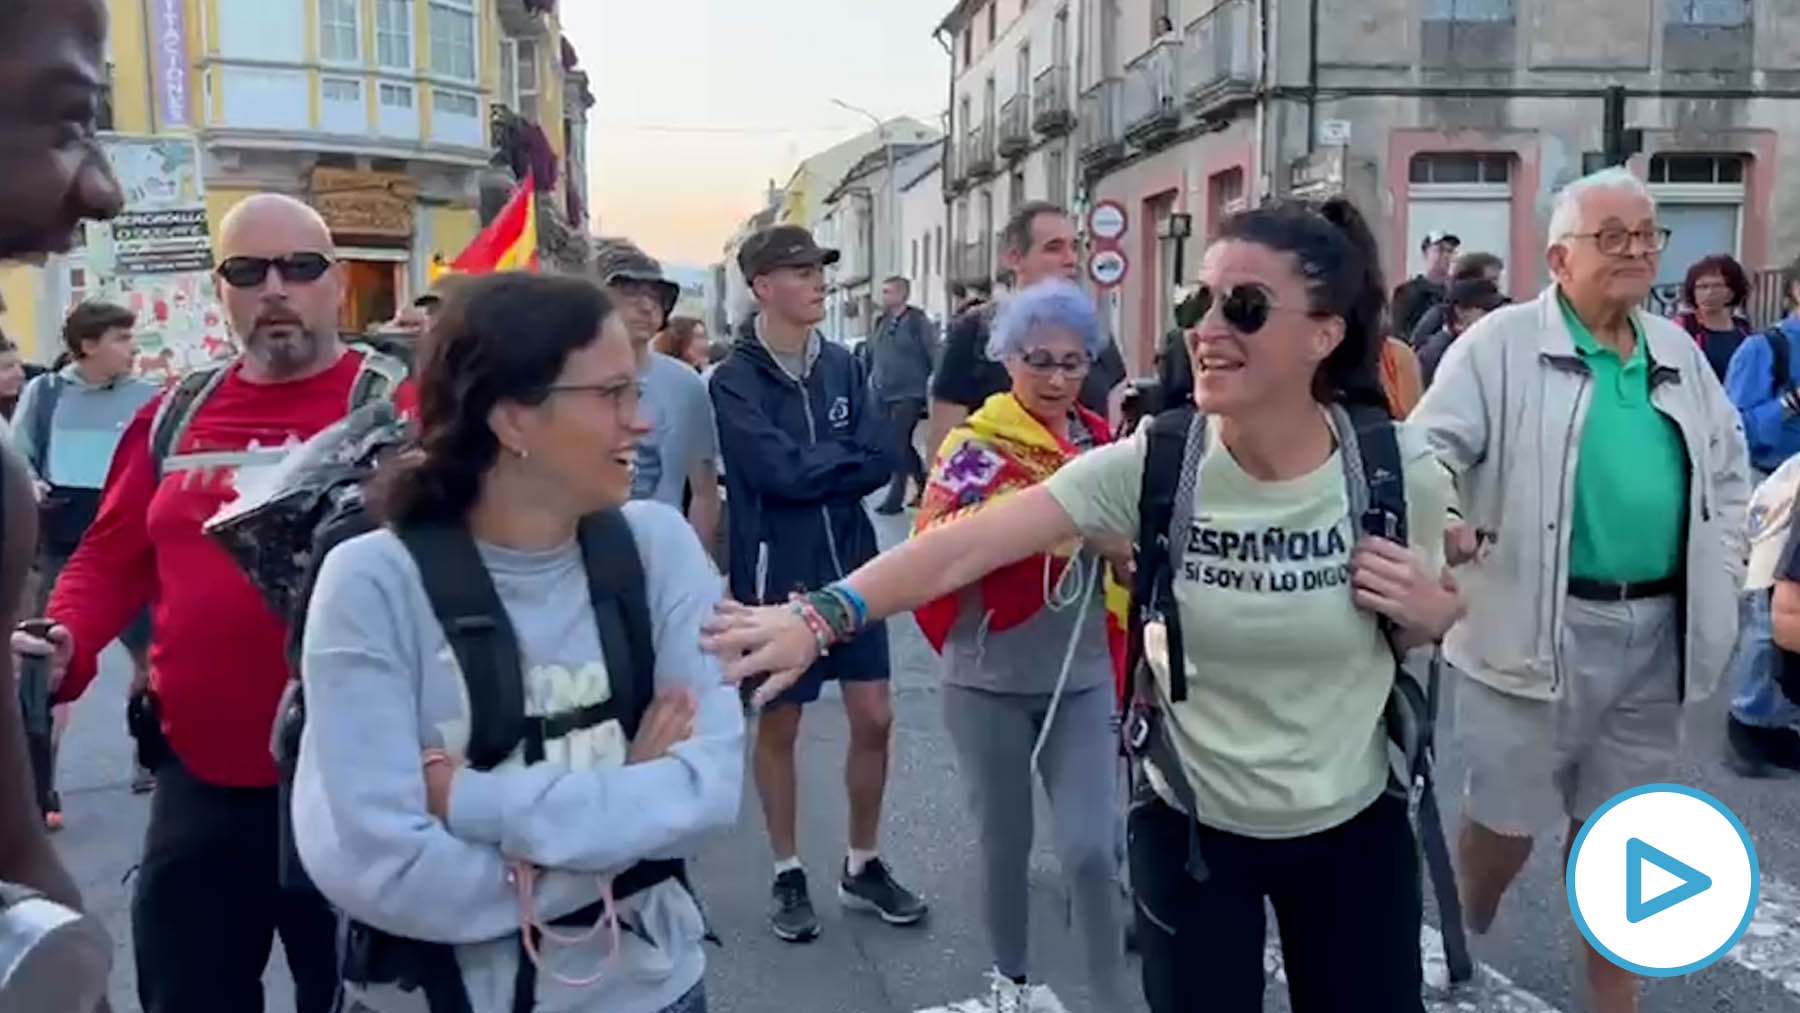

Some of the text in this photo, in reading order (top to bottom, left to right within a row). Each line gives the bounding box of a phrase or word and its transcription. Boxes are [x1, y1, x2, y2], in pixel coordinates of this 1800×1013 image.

[1187, 525, 1346, 563] ESPAÑOLA
[1203, 564, 1244, 590] SOY
[1250, 572, 1264, 592] Y
[1270, 571, 1298, 592] LO
[1303, 563, 1349, 591] DIGO
